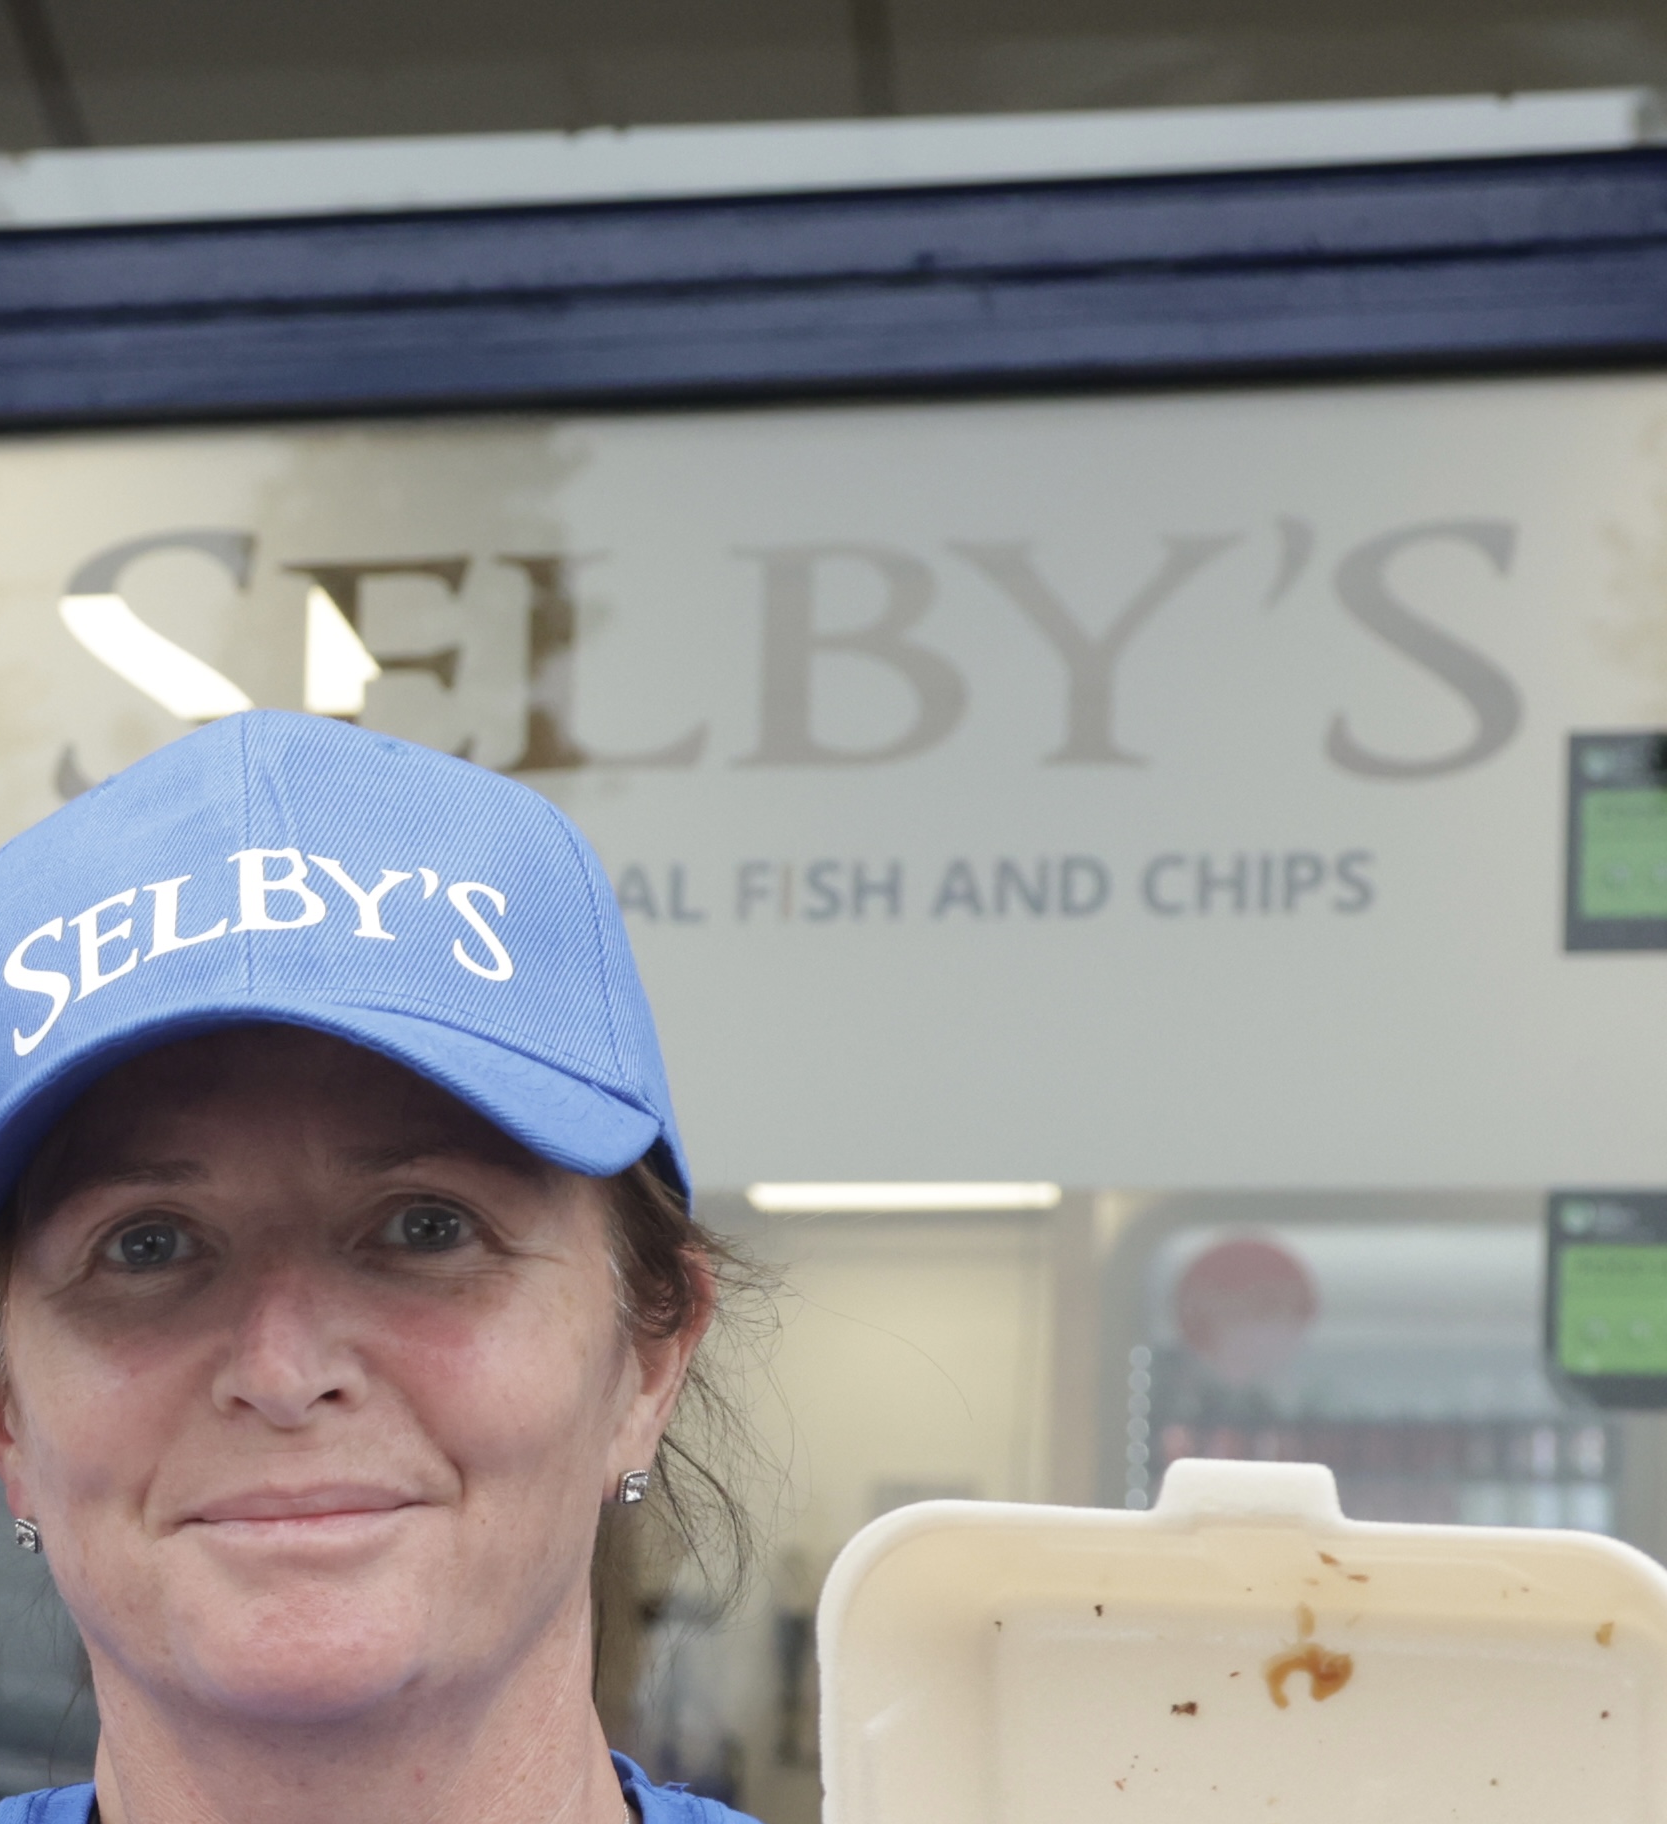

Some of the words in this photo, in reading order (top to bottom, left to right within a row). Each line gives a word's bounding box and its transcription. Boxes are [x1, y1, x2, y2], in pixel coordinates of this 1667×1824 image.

[3, 847, 515, 1057] SELBY'S
[734, 854, 905, 924] FISH
[929, 851, 1113, 922] AND
[1141, 847, 1378, 918] CHIPS
